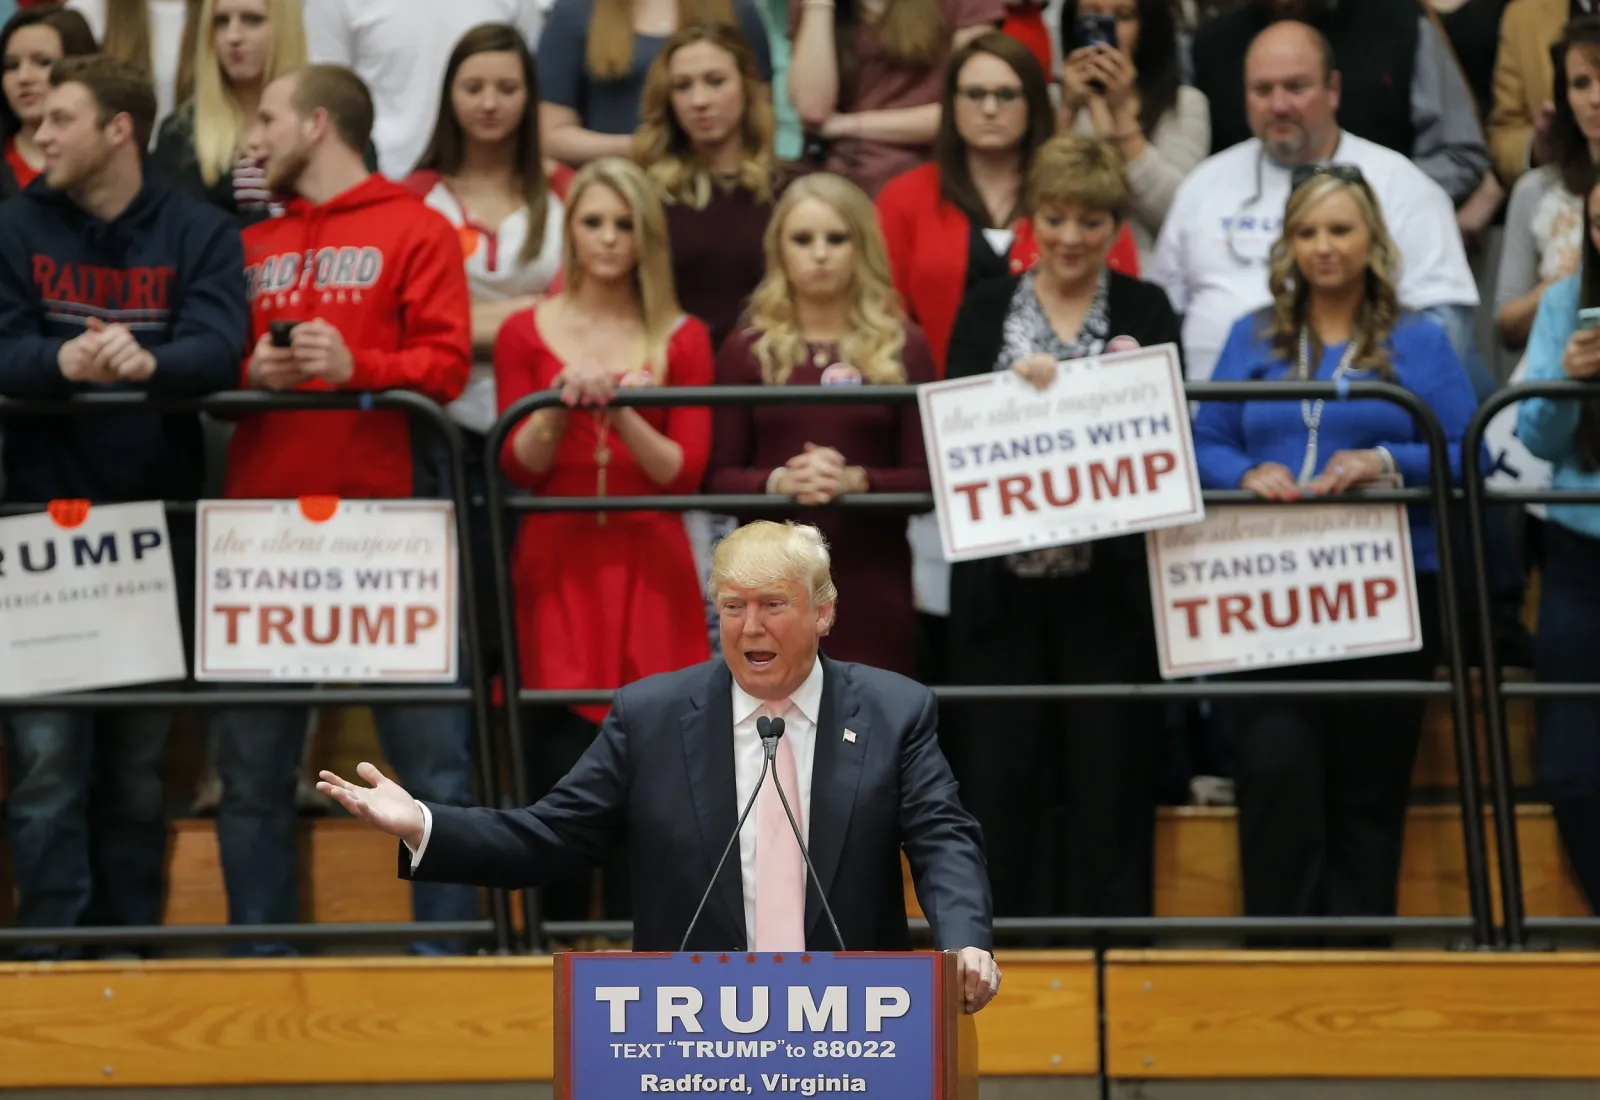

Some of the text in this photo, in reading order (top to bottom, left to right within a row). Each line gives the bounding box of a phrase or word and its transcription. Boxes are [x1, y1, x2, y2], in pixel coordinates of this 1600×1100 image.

[947, 413, 1173, 470] STANDS WITH
[953, 451, 1177, 522] TRUMP
[0, 527, 162, 578] UMP
[1168, 540, 1394, 586] STANDS WITH
[213, 567, 439, 592] STANDS WITH
[212, 603, 439, 646] TRUMP
[1172, 576, 1398, 638] TRUMP
[595, 985, 911, 1034] TRUMP
[609, 1043, 665, 1058] TEXT
[785, 1043, 807, 1058] to
[812, 1040, 896, 1058] 88022
[640, 1073, 867, 1097] Radford, Virginia
